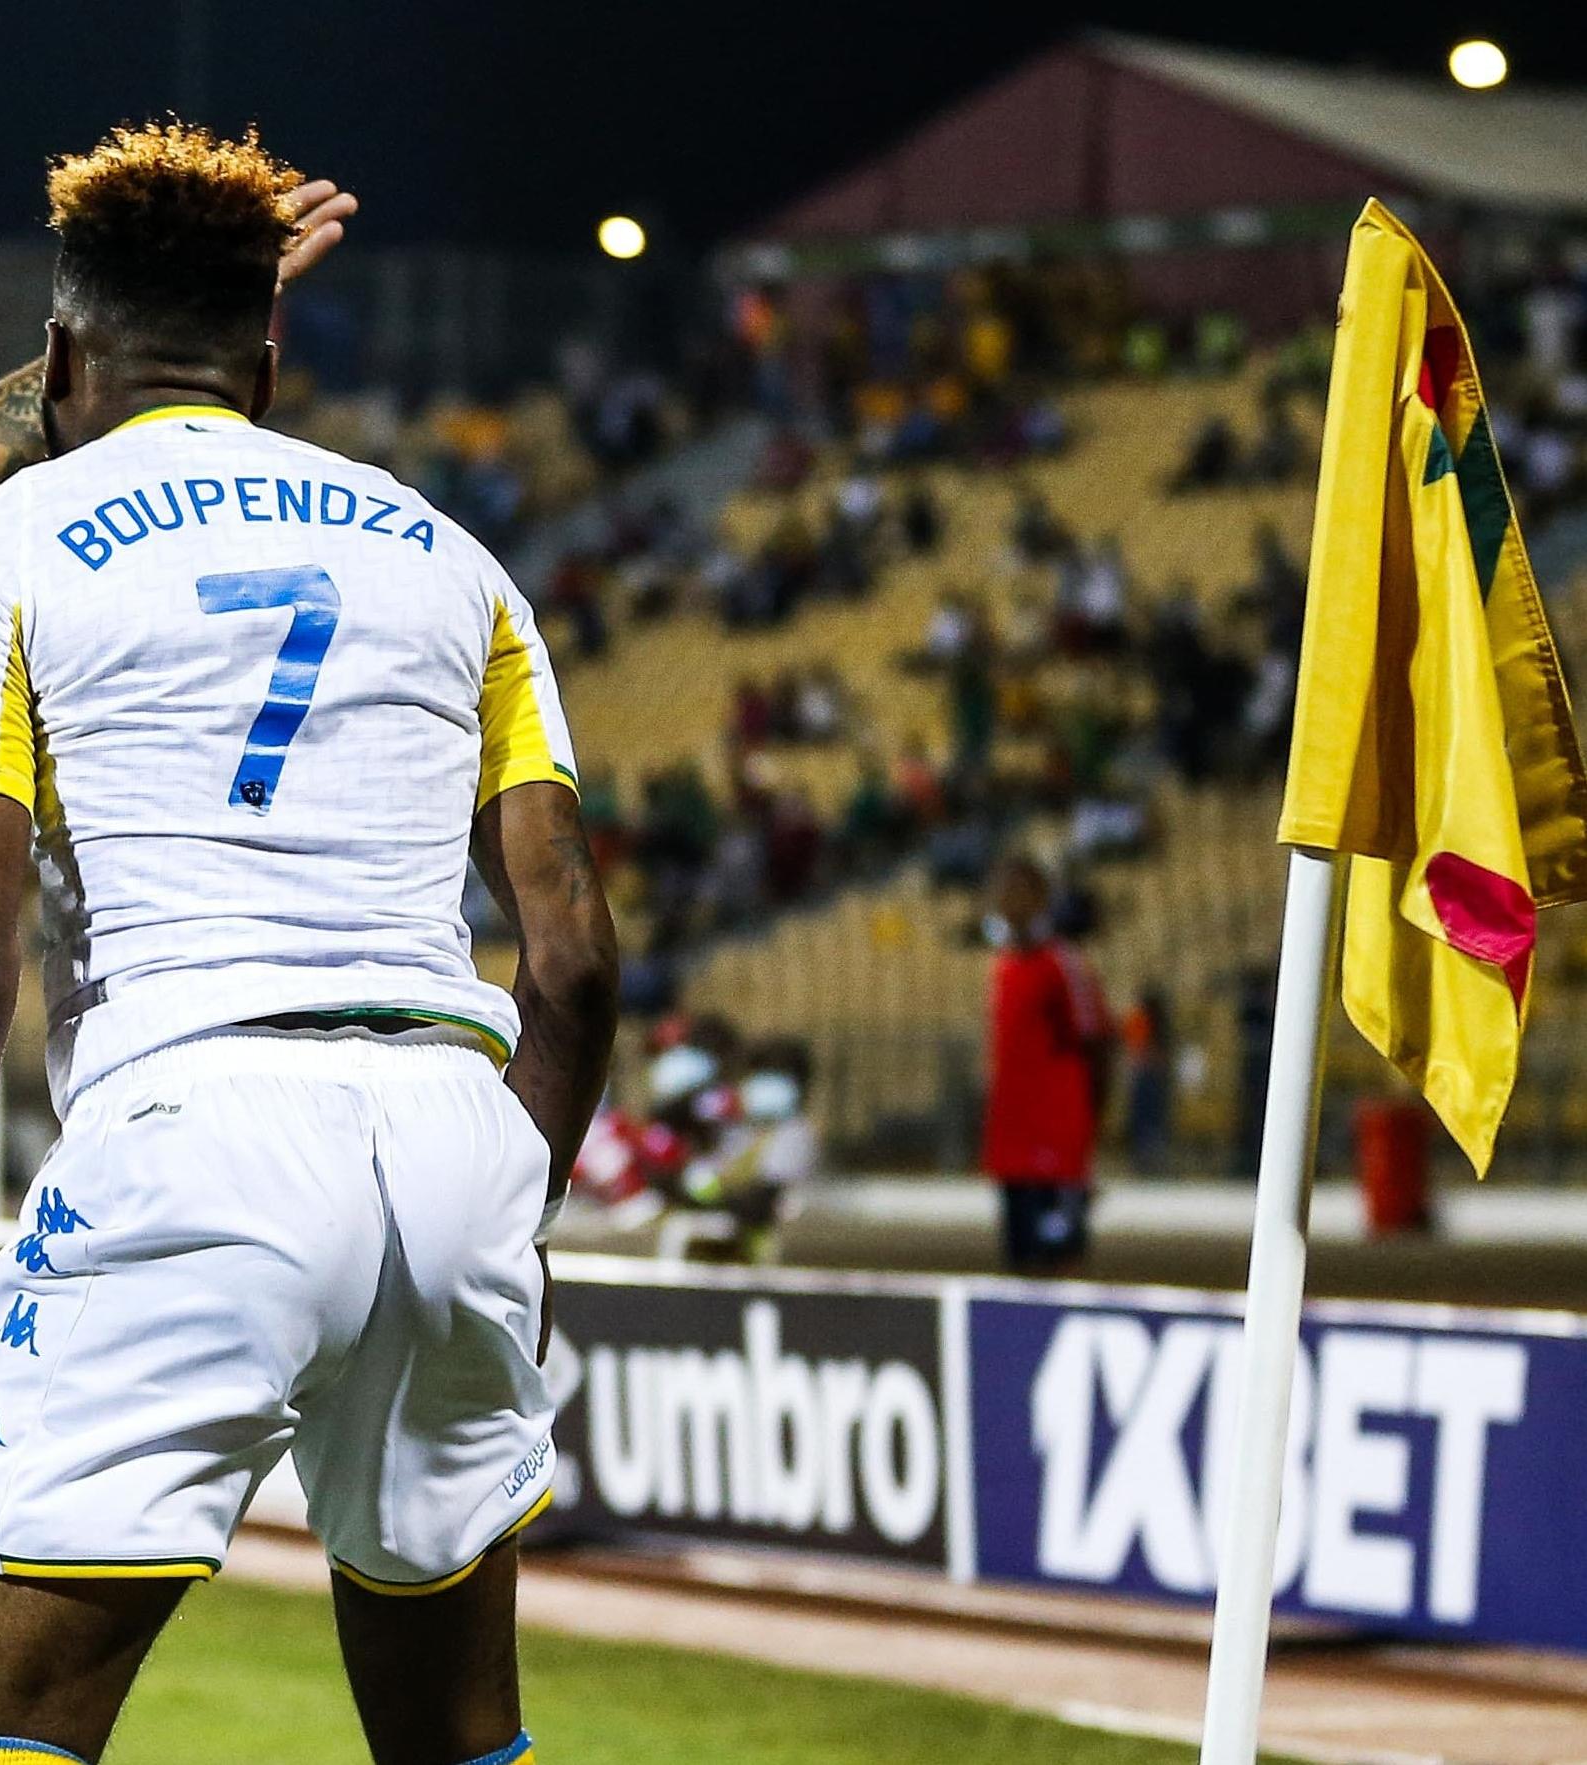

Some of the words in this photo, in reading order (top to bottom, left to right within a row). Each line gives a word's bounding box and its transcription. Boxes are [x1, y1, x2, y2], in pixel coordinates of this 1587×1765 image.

[58, 477, 437, 571] BOUPENDZA
[196, 564, 342, 816] 7
[502, 1438, 550, 1499] Kappa
[589, 1301, 940, 1546] umbro
